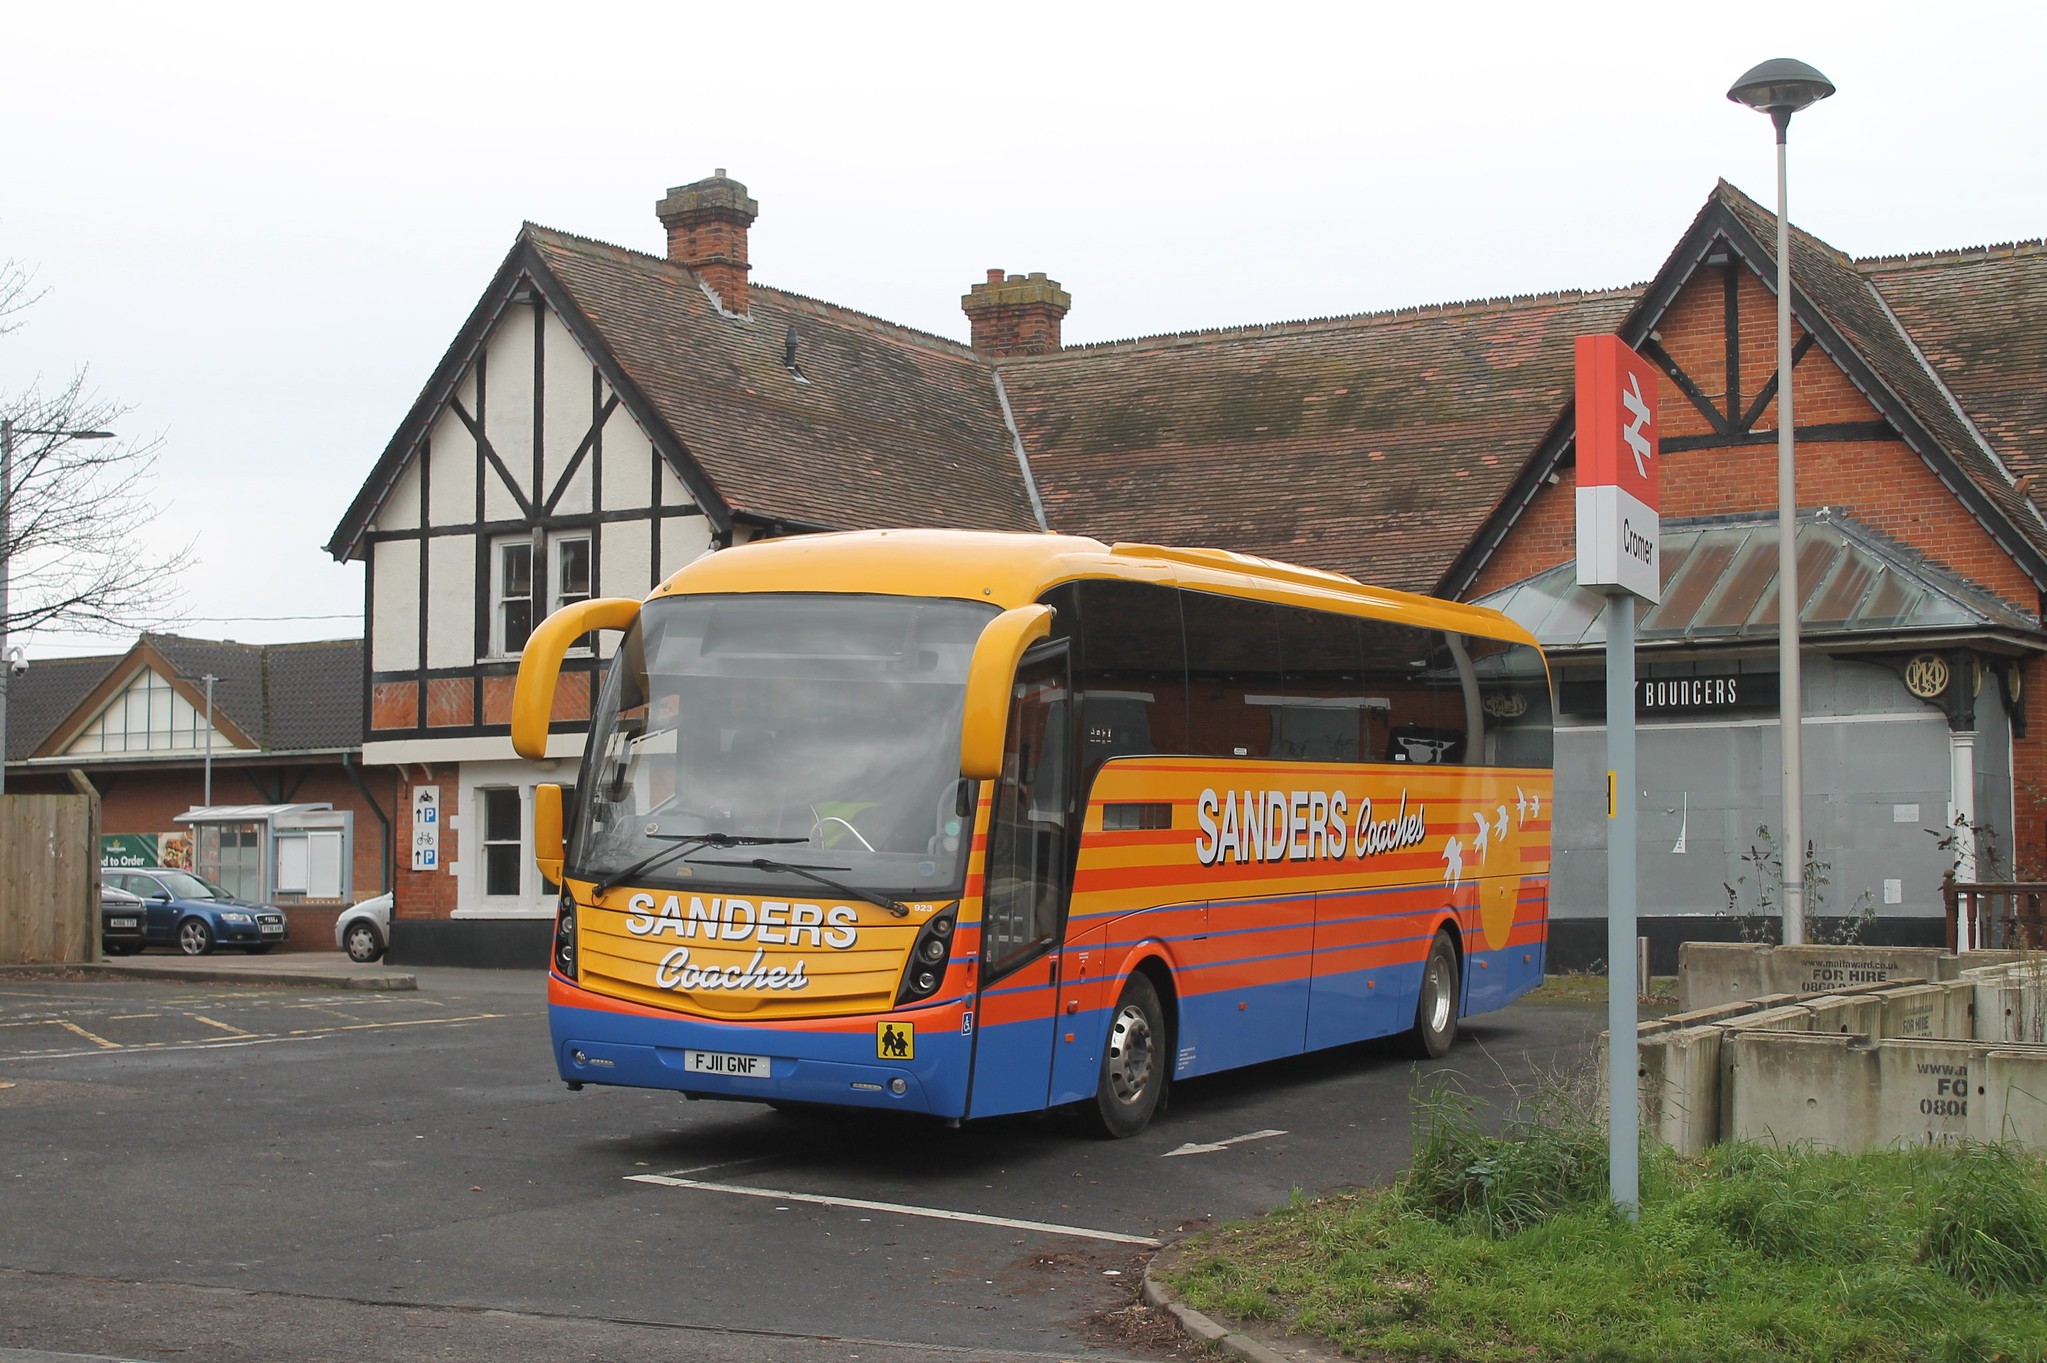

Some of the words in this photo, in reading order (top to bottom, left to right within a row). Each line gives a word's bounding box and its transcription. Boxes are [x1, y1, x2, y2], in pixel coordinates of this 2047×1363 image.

[1623, 518, 1653, 566] Cromer
[1645, 679, 1736, 706] BOUNCERS
[1195, 788, 1348, 865] SANDERS
[1354, 787, 1425, 858] Coaches
[110, 856, 119, 867] to
[120, 854, 145, 867] Order
[625, 893, 858, 948] SANDERS
[913, 903, 933, 913] 923
[655, 946, 809, 991] Coaches
[1812, 969, 1844, 981] FOR
[1848, 970, 1887, 982] HIRE
[727, 1056, 758, 1073] GNF
